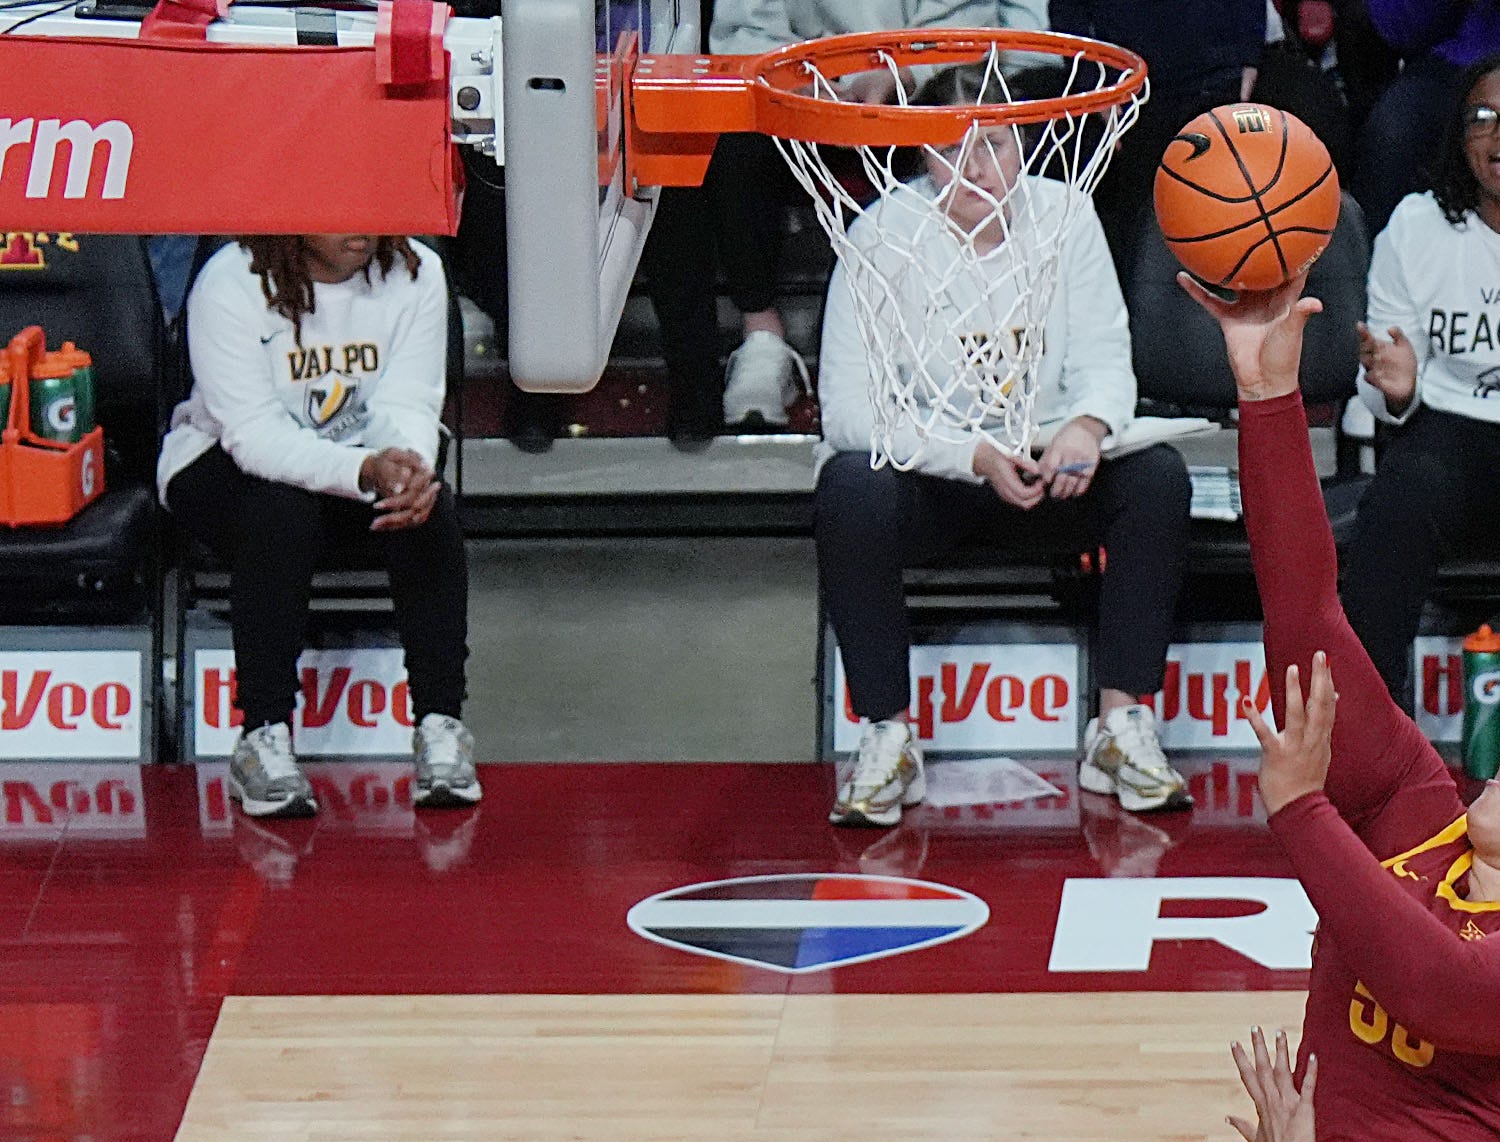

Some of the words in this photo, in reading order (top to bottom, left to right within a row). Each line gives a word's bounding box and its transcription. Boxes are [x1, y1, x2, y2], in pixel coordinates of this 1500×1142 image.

[0, 117, 134, 199] rm
[287, 343, 379, 382] VALPO
[1, 669, 132, 731] Vee
